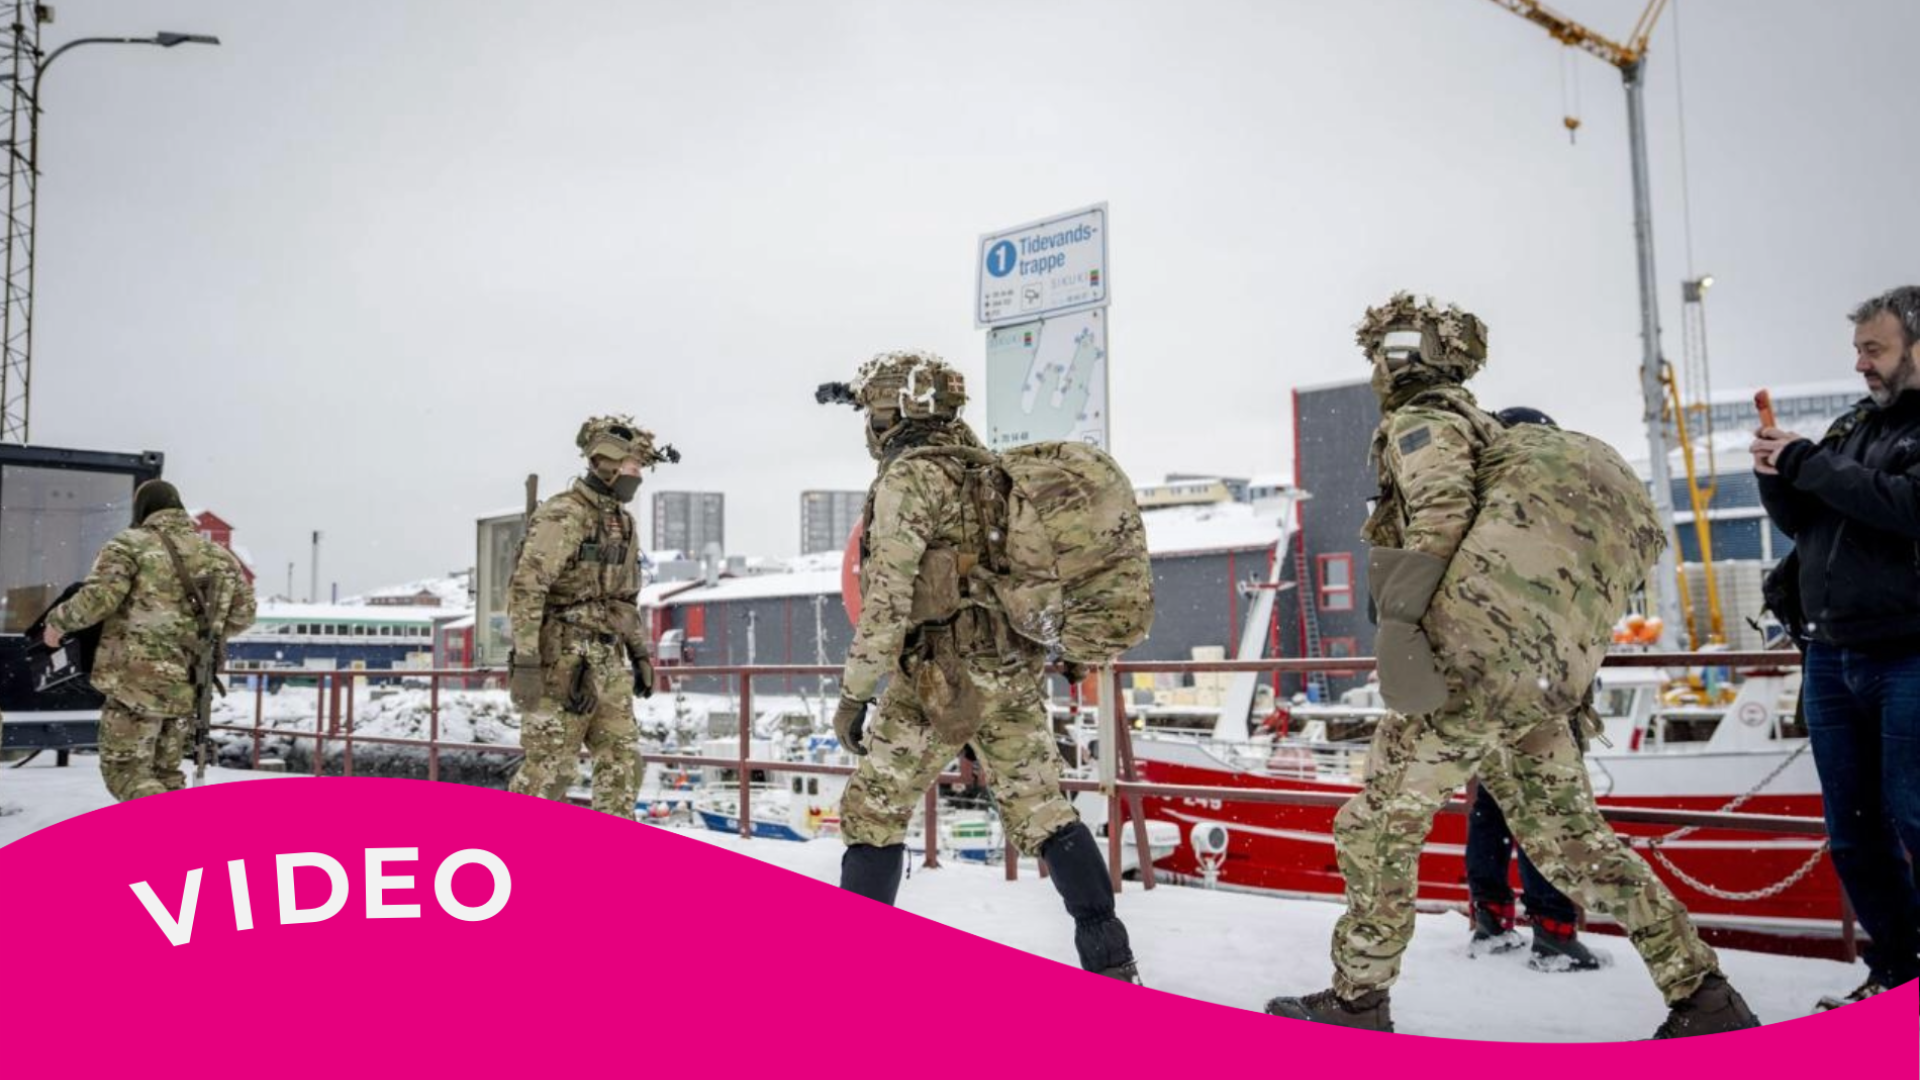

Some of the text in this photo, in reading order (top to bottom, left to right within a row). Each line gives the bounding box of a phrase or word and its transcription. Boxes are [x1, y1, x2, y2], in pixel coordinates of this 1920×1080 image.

[1019, 224, 1098, 255] Tidevands-
[995, 245, 1007, 271] 1
[1019, 251, 1065, 276] trappe
